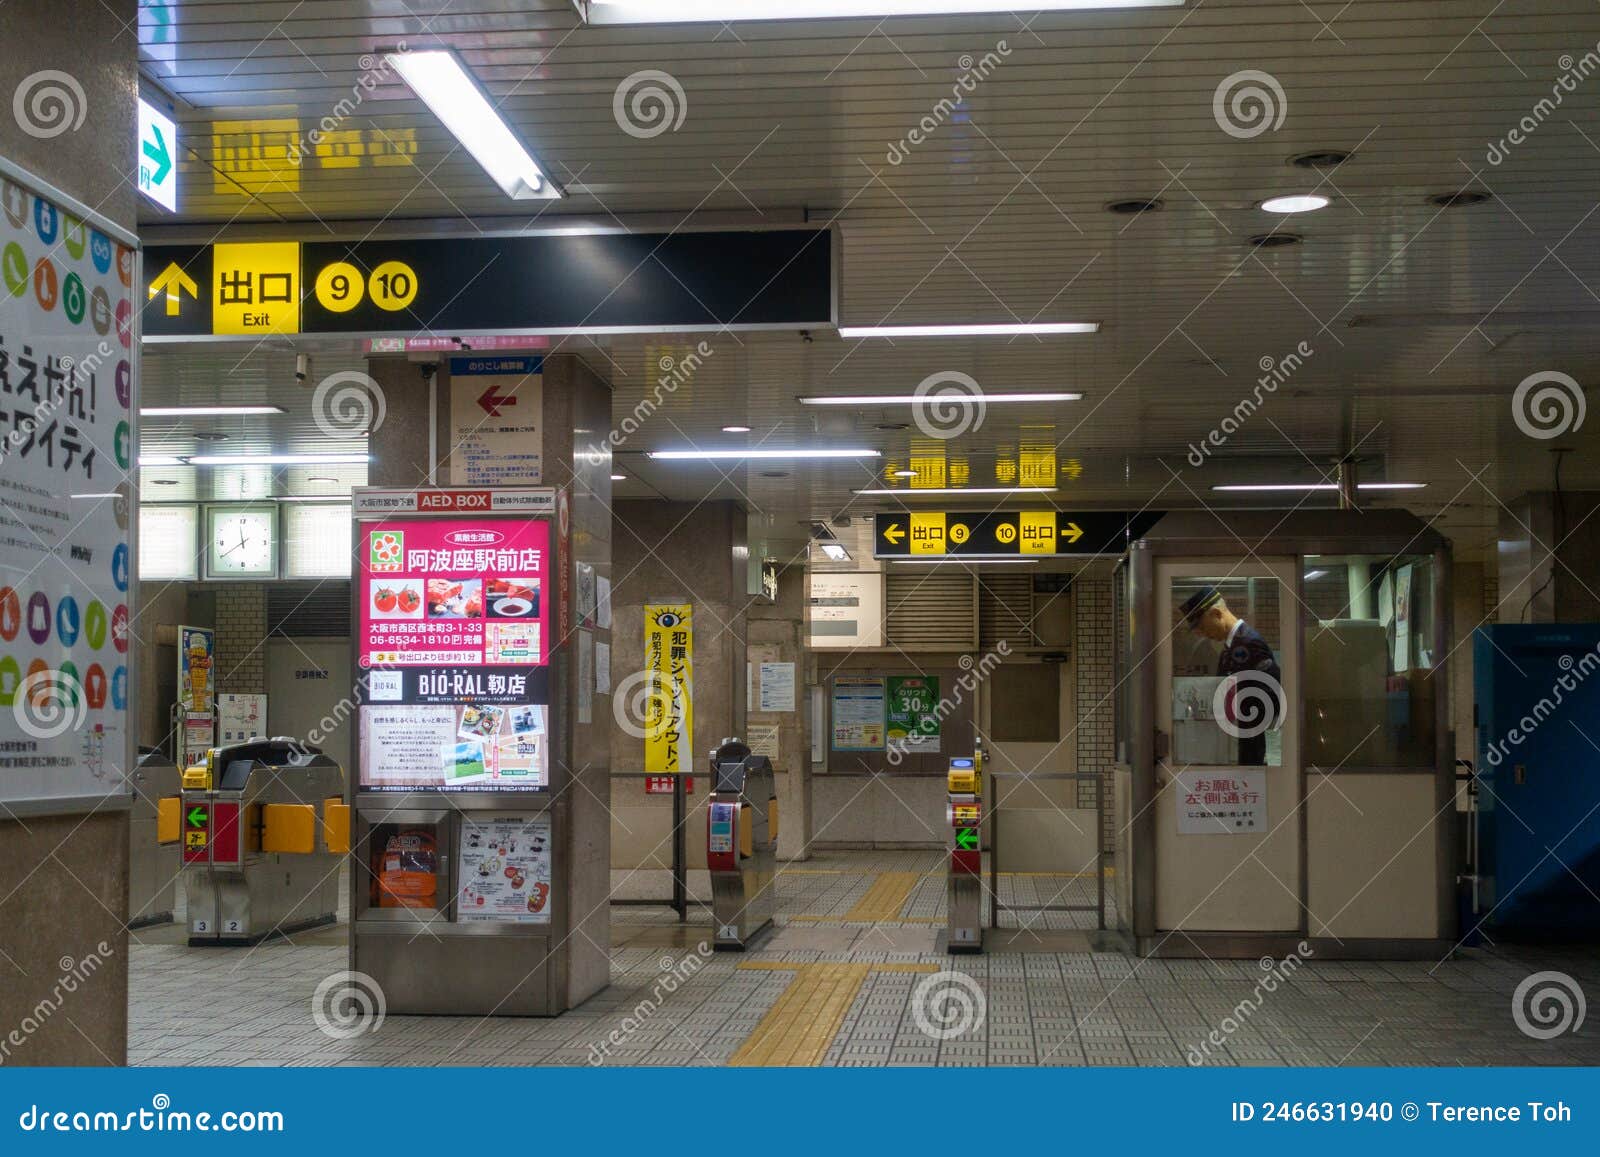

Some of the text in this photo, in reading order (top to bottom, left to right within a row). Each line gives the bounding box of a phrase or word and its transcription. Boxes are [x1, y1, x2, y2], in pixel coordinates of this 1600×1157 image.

[220, 270, 411, 305] 出口 9 10
[243, 313, 270, 326] Exit
[421, 494, 451, 507] AED
[457, 494, 487, 507] BOX
[913, 526, 964, 541] 出口 9
[1000, 525, 1053, 541] 10 出口
[407, 548, 541, 572] 阿波座駅前店
[369, 623, 483, 633] 大阪市西区西本町3-1-33
[369, 635, 450, 645] 06-6534-1810
[1195, 779, 1249, 792] お願い
[1185, 792, 1260, 805] 左側通行
[199, 922, 207, 931] 3
[230, 922, 238, 931] 2
